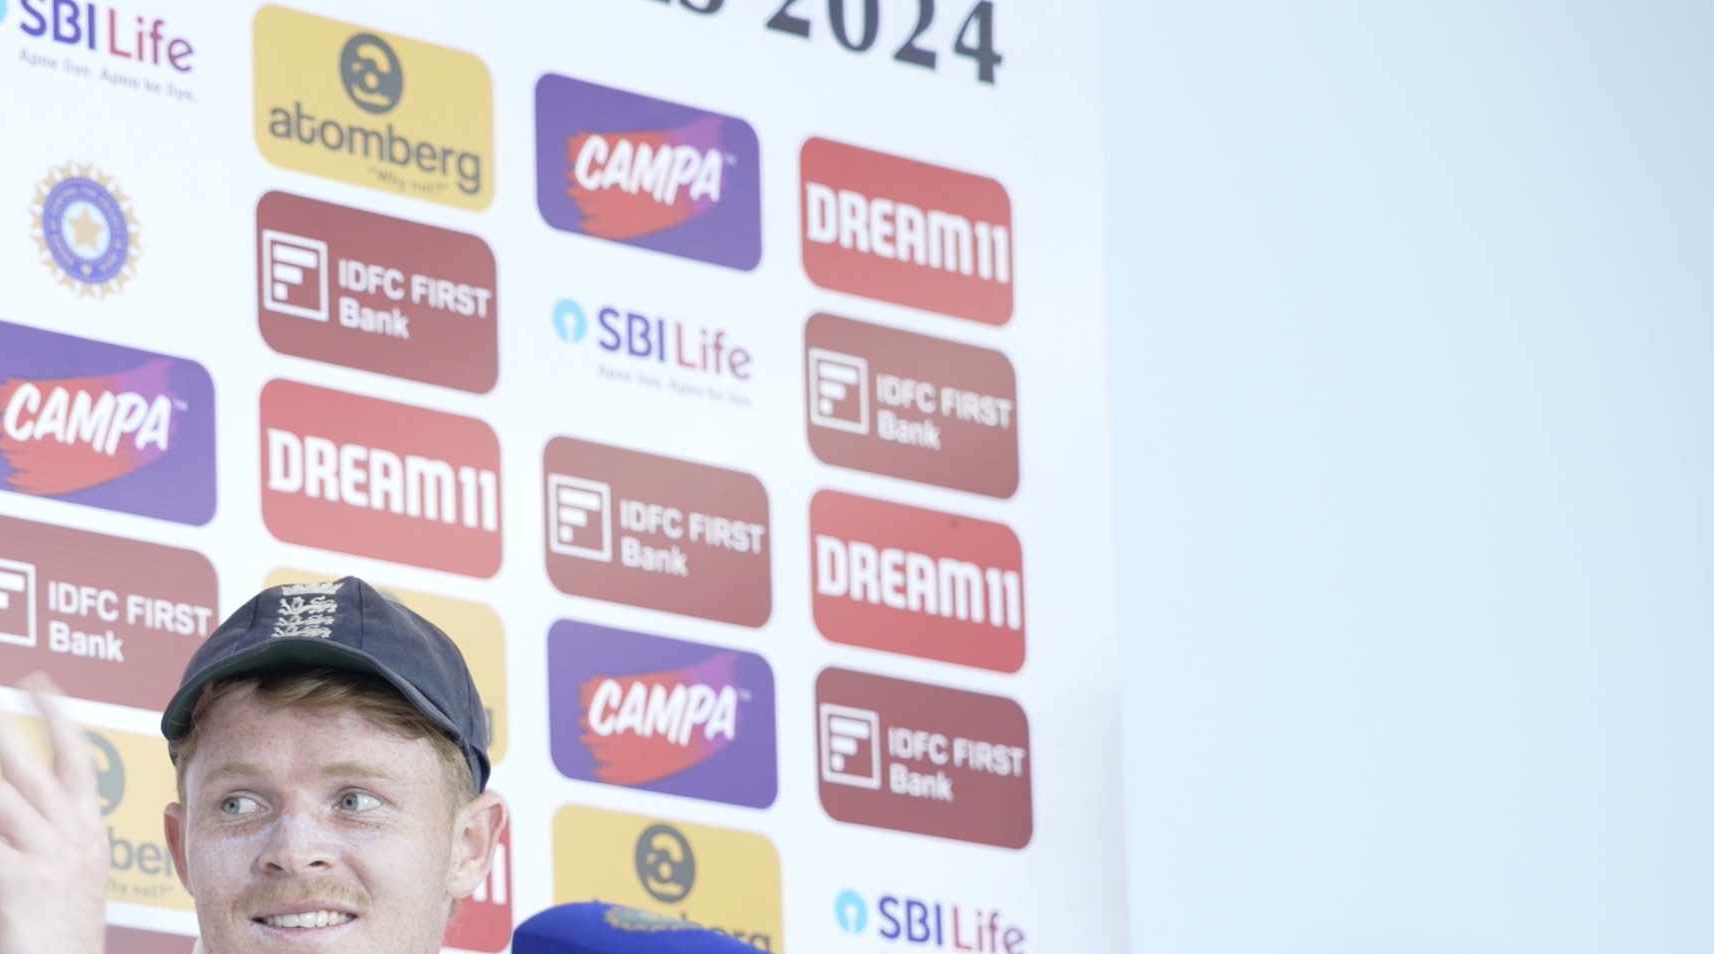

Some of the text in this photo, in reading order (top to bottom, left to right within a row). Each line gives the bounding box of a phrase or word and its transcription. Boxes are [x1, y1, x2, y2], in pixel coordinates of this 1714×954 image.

[20, 0, 194, 73] SBI Life
[268, 101, 481, 196] atomberg
[574, 134, 722, 206] CAMPA
[806, 182, 1010, 284] DREAM11
[338, 257, 492, 318] IDFC FIRST
[338, 296, 410, 340] Bank
[598, 305, 752, 381] SBI Life
[2, 383, 171, 456] CAMPA
[877, 374, 1012, 428] IDFC FIRST
[877, 410, 941, 450] Bank
[267, 428, 496, 532] DREAM11
[619, 499, 765, 554] IDFC FIRST
[620, 537, 688, 578] Bank
[816, 535, 1022, 630] DREAM11
[49, 580, 212, 637] IDFC FIRST
[49, 621, 124, 662] Bank
[588, 679, 737, 747] CAMPA
[889, 727, 1026, 777] IDFC FIRST
[889, 763, 953, 802] Bank
[879, 896, 942, 945] SBI
